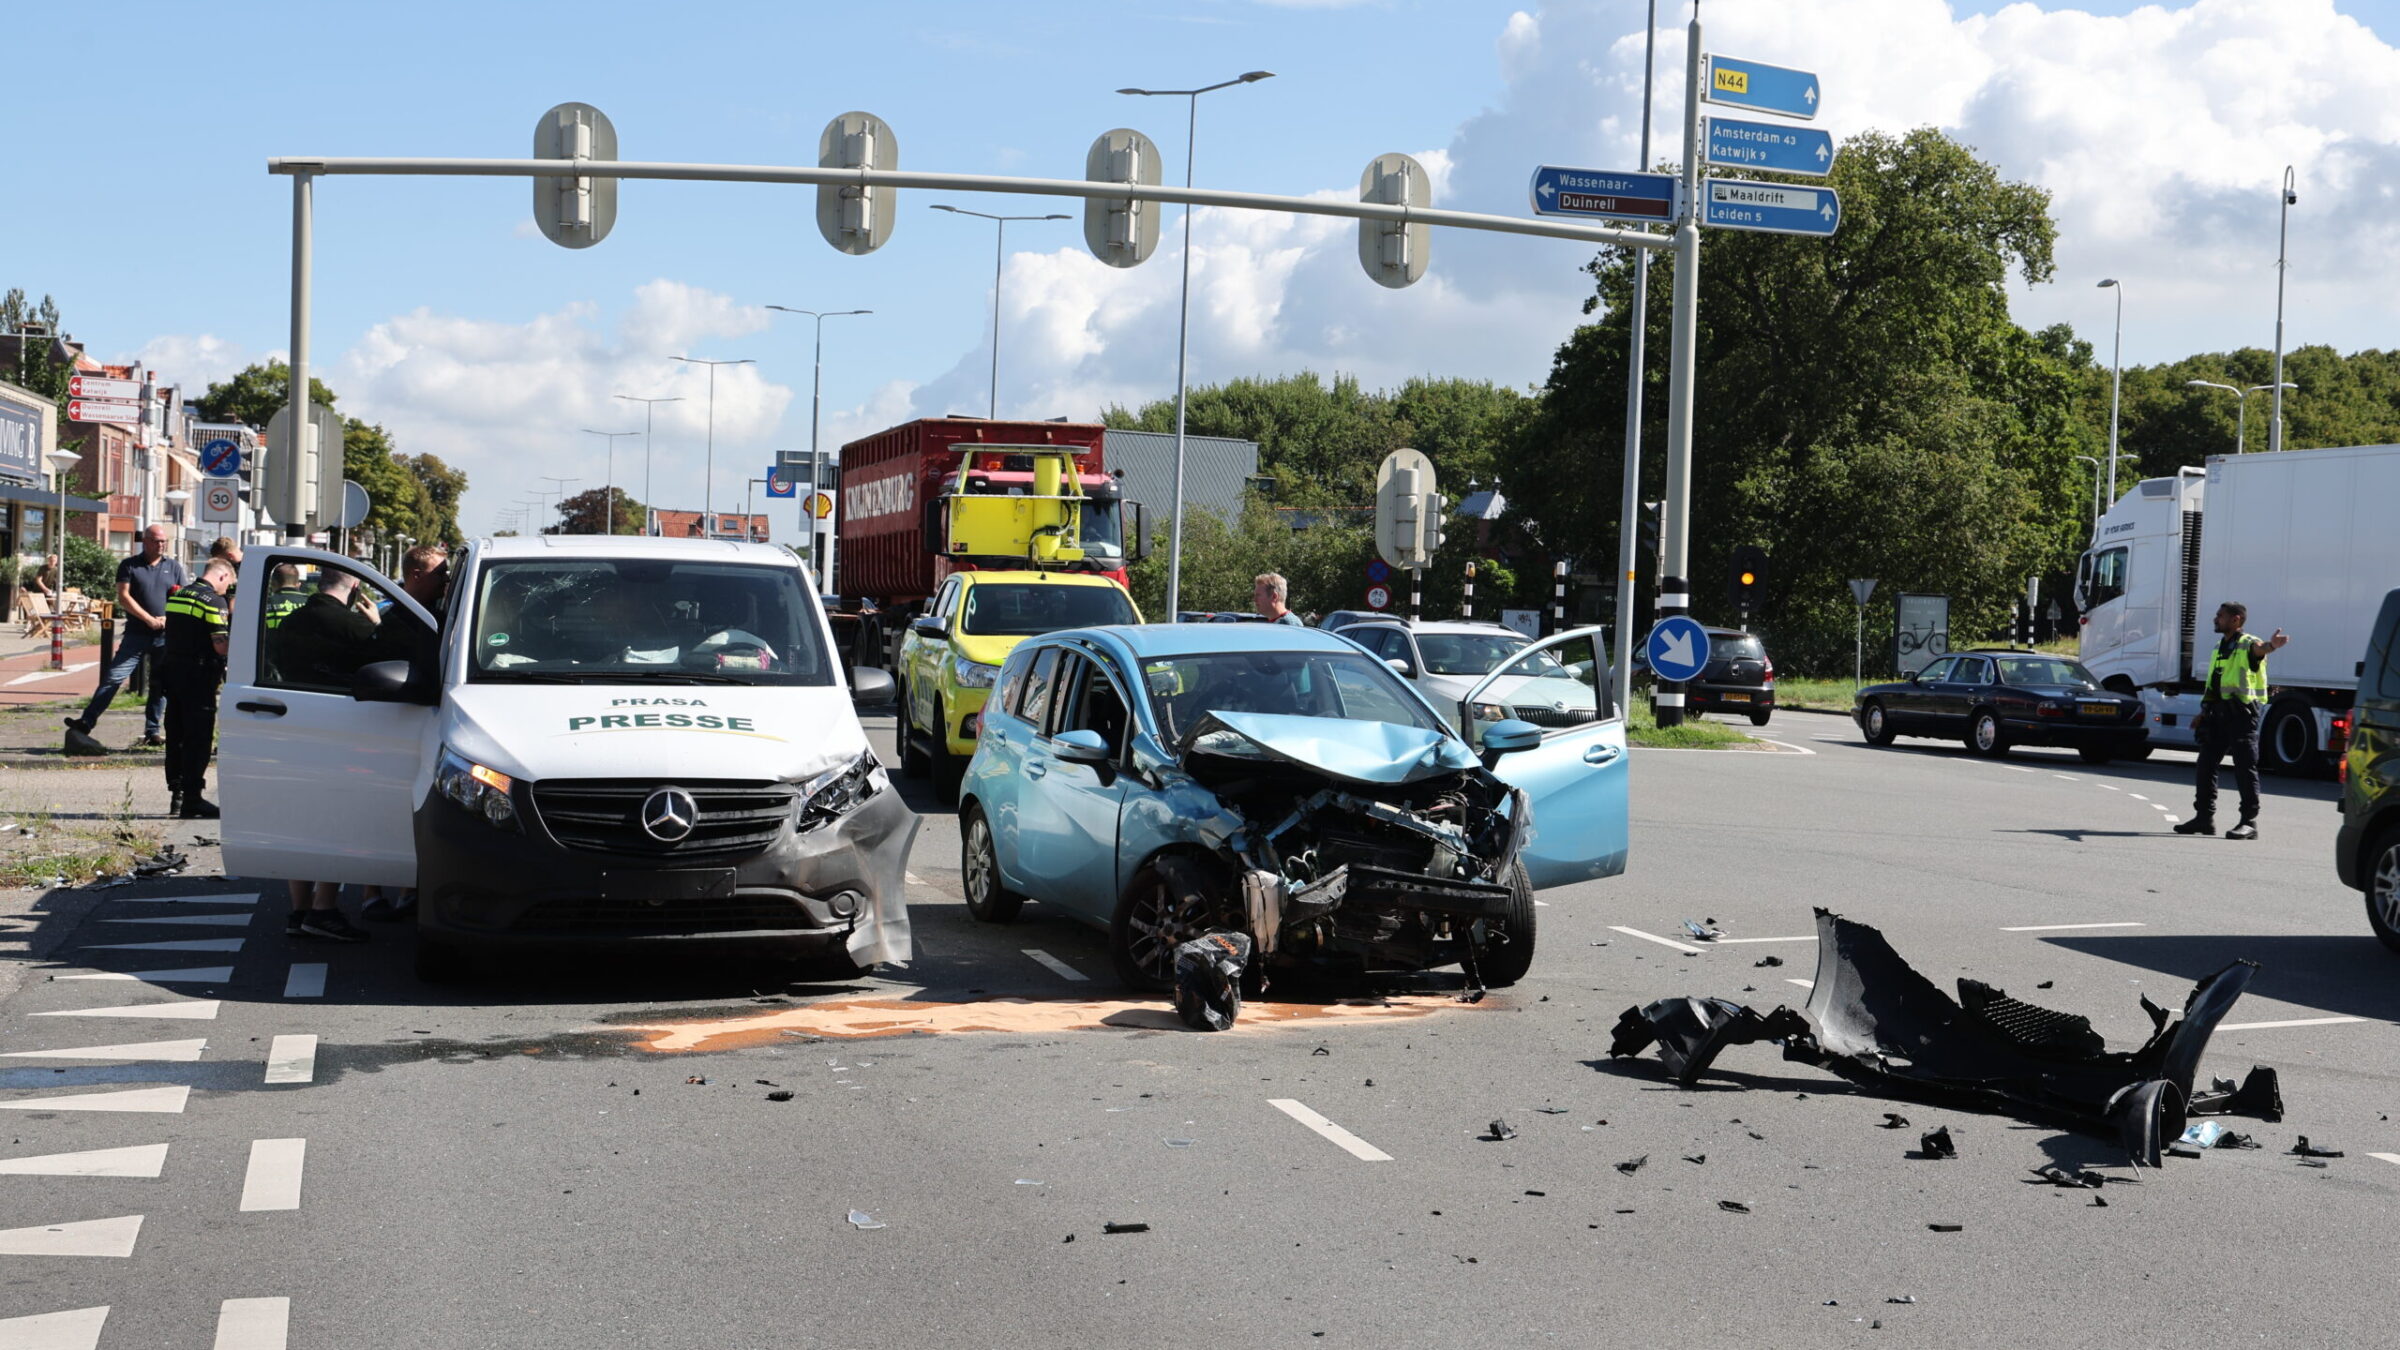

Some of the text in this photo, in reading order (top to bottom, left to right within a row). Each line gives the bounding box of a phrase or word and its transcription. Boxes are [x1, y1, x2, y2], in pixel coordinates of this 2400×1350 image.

[1718, 73, 1744, 89] N44
[1713, 125, 1796, 146] Amsterdam 43
[1712, 144, 1767, 162] Katwijk 9
[1562, 194, 1616, 211] Duinrell
[1730, 189, 1784, 204] Maaldrift
[1711, 206, 1762, 222] Leiden 5
[82, 380, 111, 388] Centrum
[82, 388, 107, 396] Katwijk
[82, 403, 111, 411] Duinrell
[212, 494, 230, 505] 30
[612, 698, 709, 708] PRASA
[569, 713, 755, 732] PRESSE
